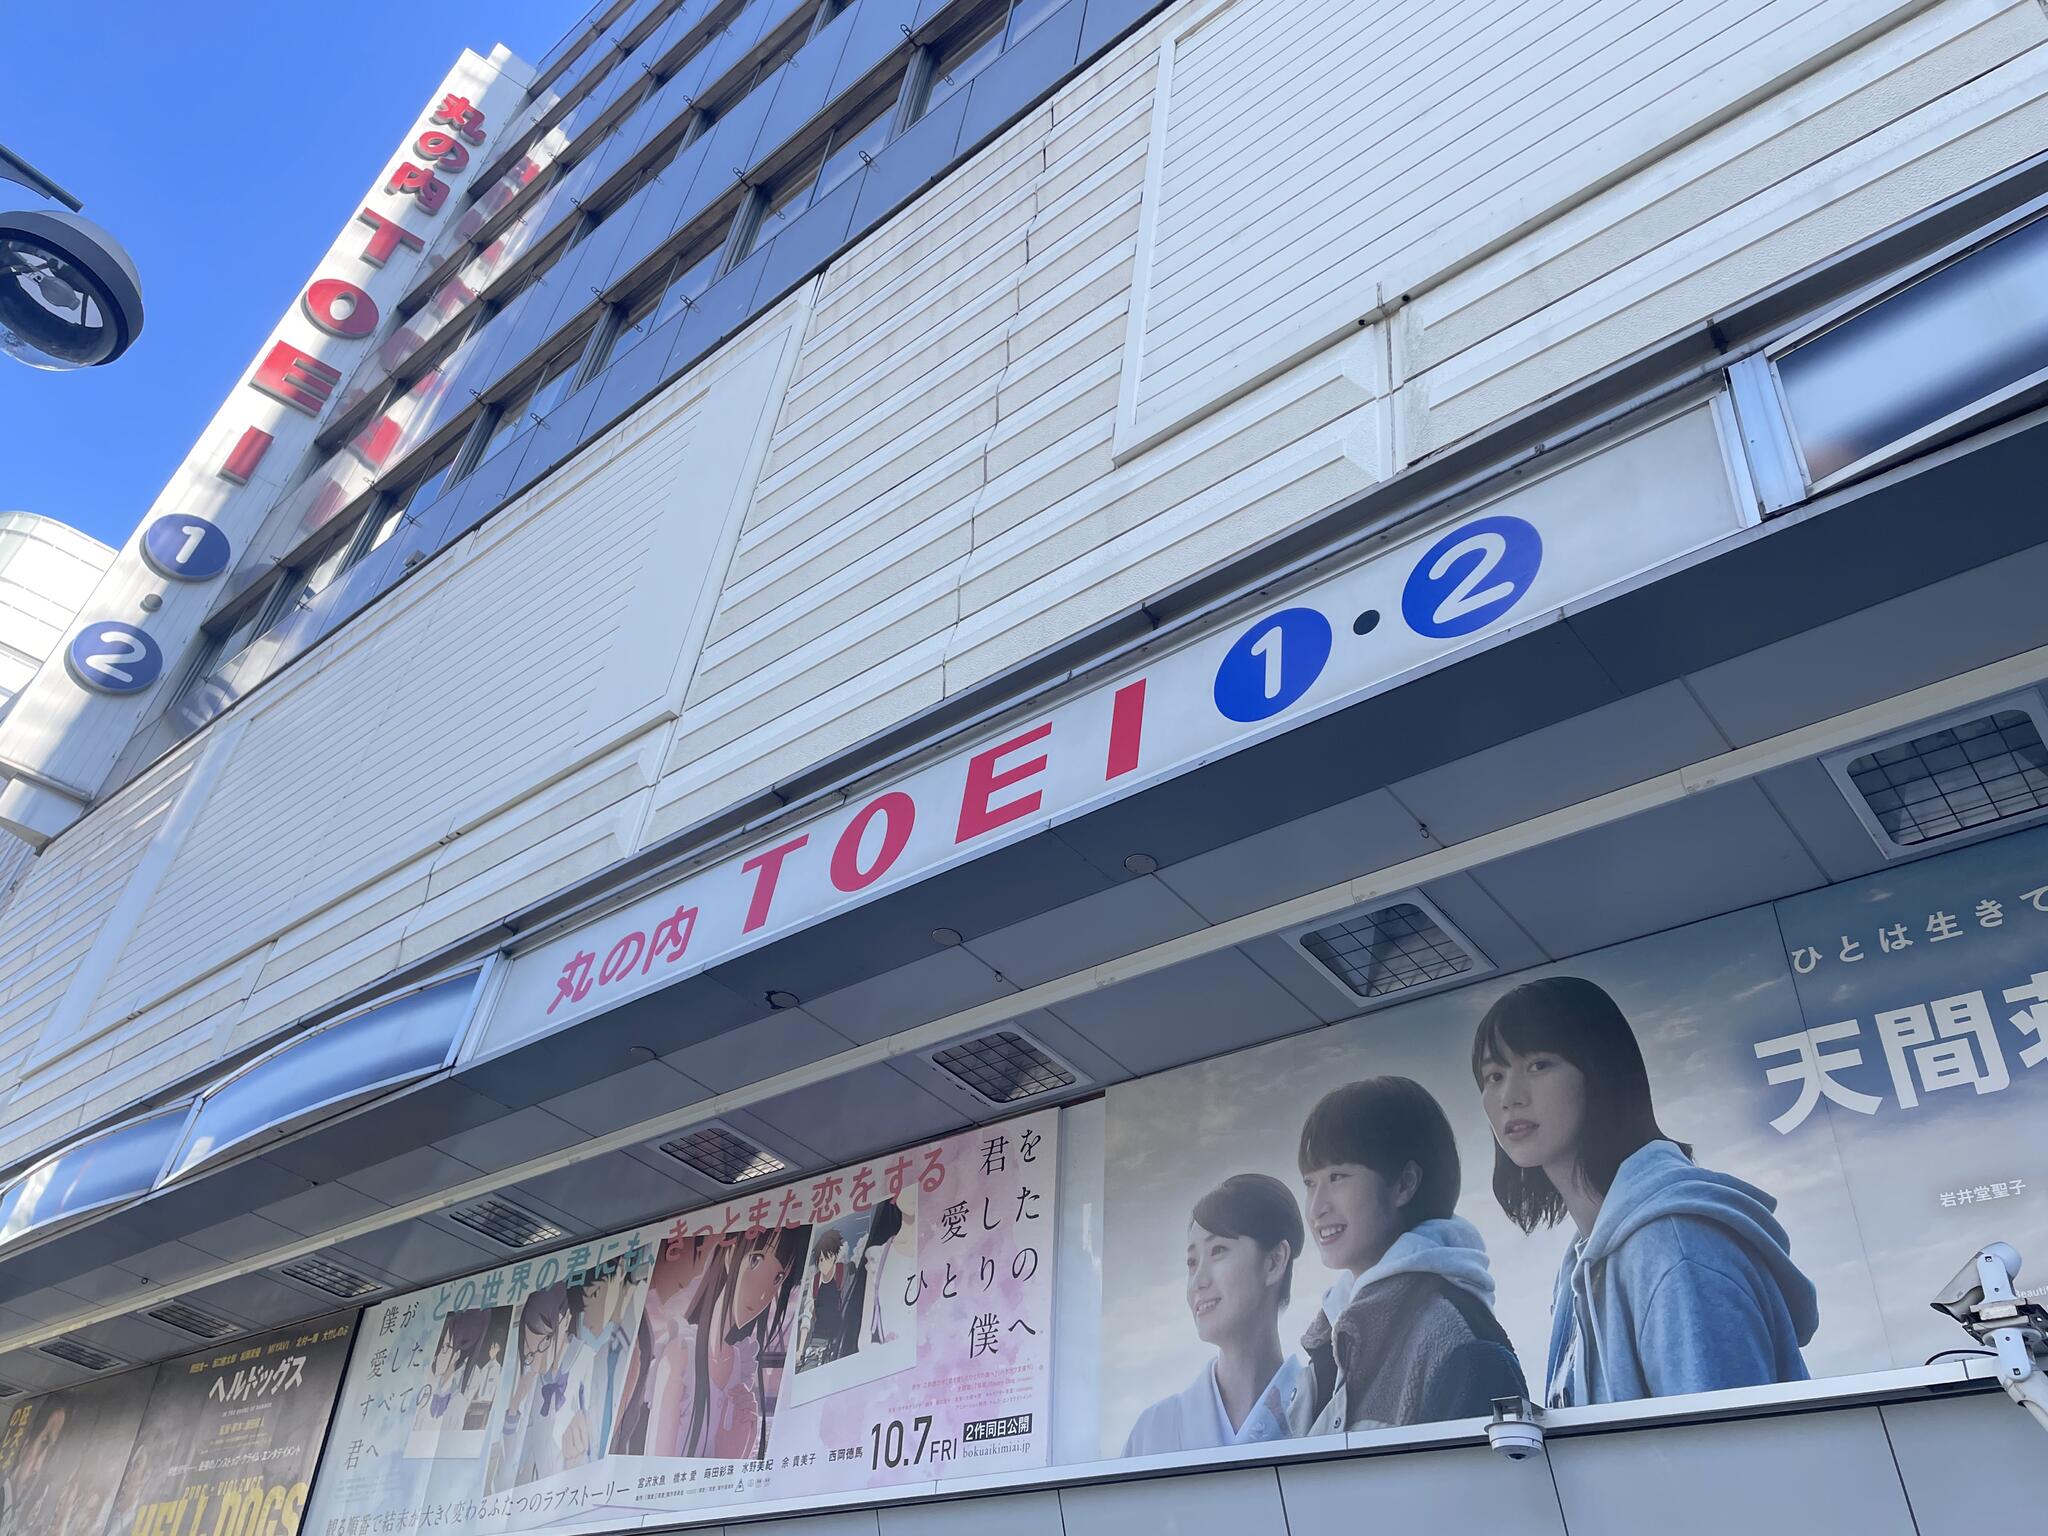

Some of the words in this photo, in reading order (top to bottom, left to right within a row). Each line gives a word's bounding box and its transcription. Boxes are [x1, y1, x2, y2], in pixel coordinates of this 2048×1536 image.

[384, 93, 487, 216] 丸の内
[216, 207, 425, 486] TOEI
[547, 904, 699, 1015] 丸の内
[741, 678, 1147, 935] TOEI
[979, 1129, 1041, 1176] 君を
[941, 1187, 1040, 1244] 愛した
[1939, 1179, 2026, 1208] 岩井堂聖子
[432, 1234, 656, 1321] どの世界の君にも、
[664, 1147, 946, 1262] きっとまた恋をする
[904, 1247, 1038, 1306] ひとりの
[379, 1301, 420, 1336] 僕が
[968, 1312, 1036, 1359] 僕へ
[208, 1355, 307, 1402] ヘルドッグス
[367, 1341, 423, 1380] 愛した
[360, 1383, 432, 1424] すべての
[871, 1415, 932, 1470] 10.7
[930, 1438, 957, 1463] FRI
[962, 1440, 1031, 1458] bokuaikimiai.jp
[965, 1415, 1031, 1441] 2作同日公開
[344, 1439, 379, 1471] 君へ
